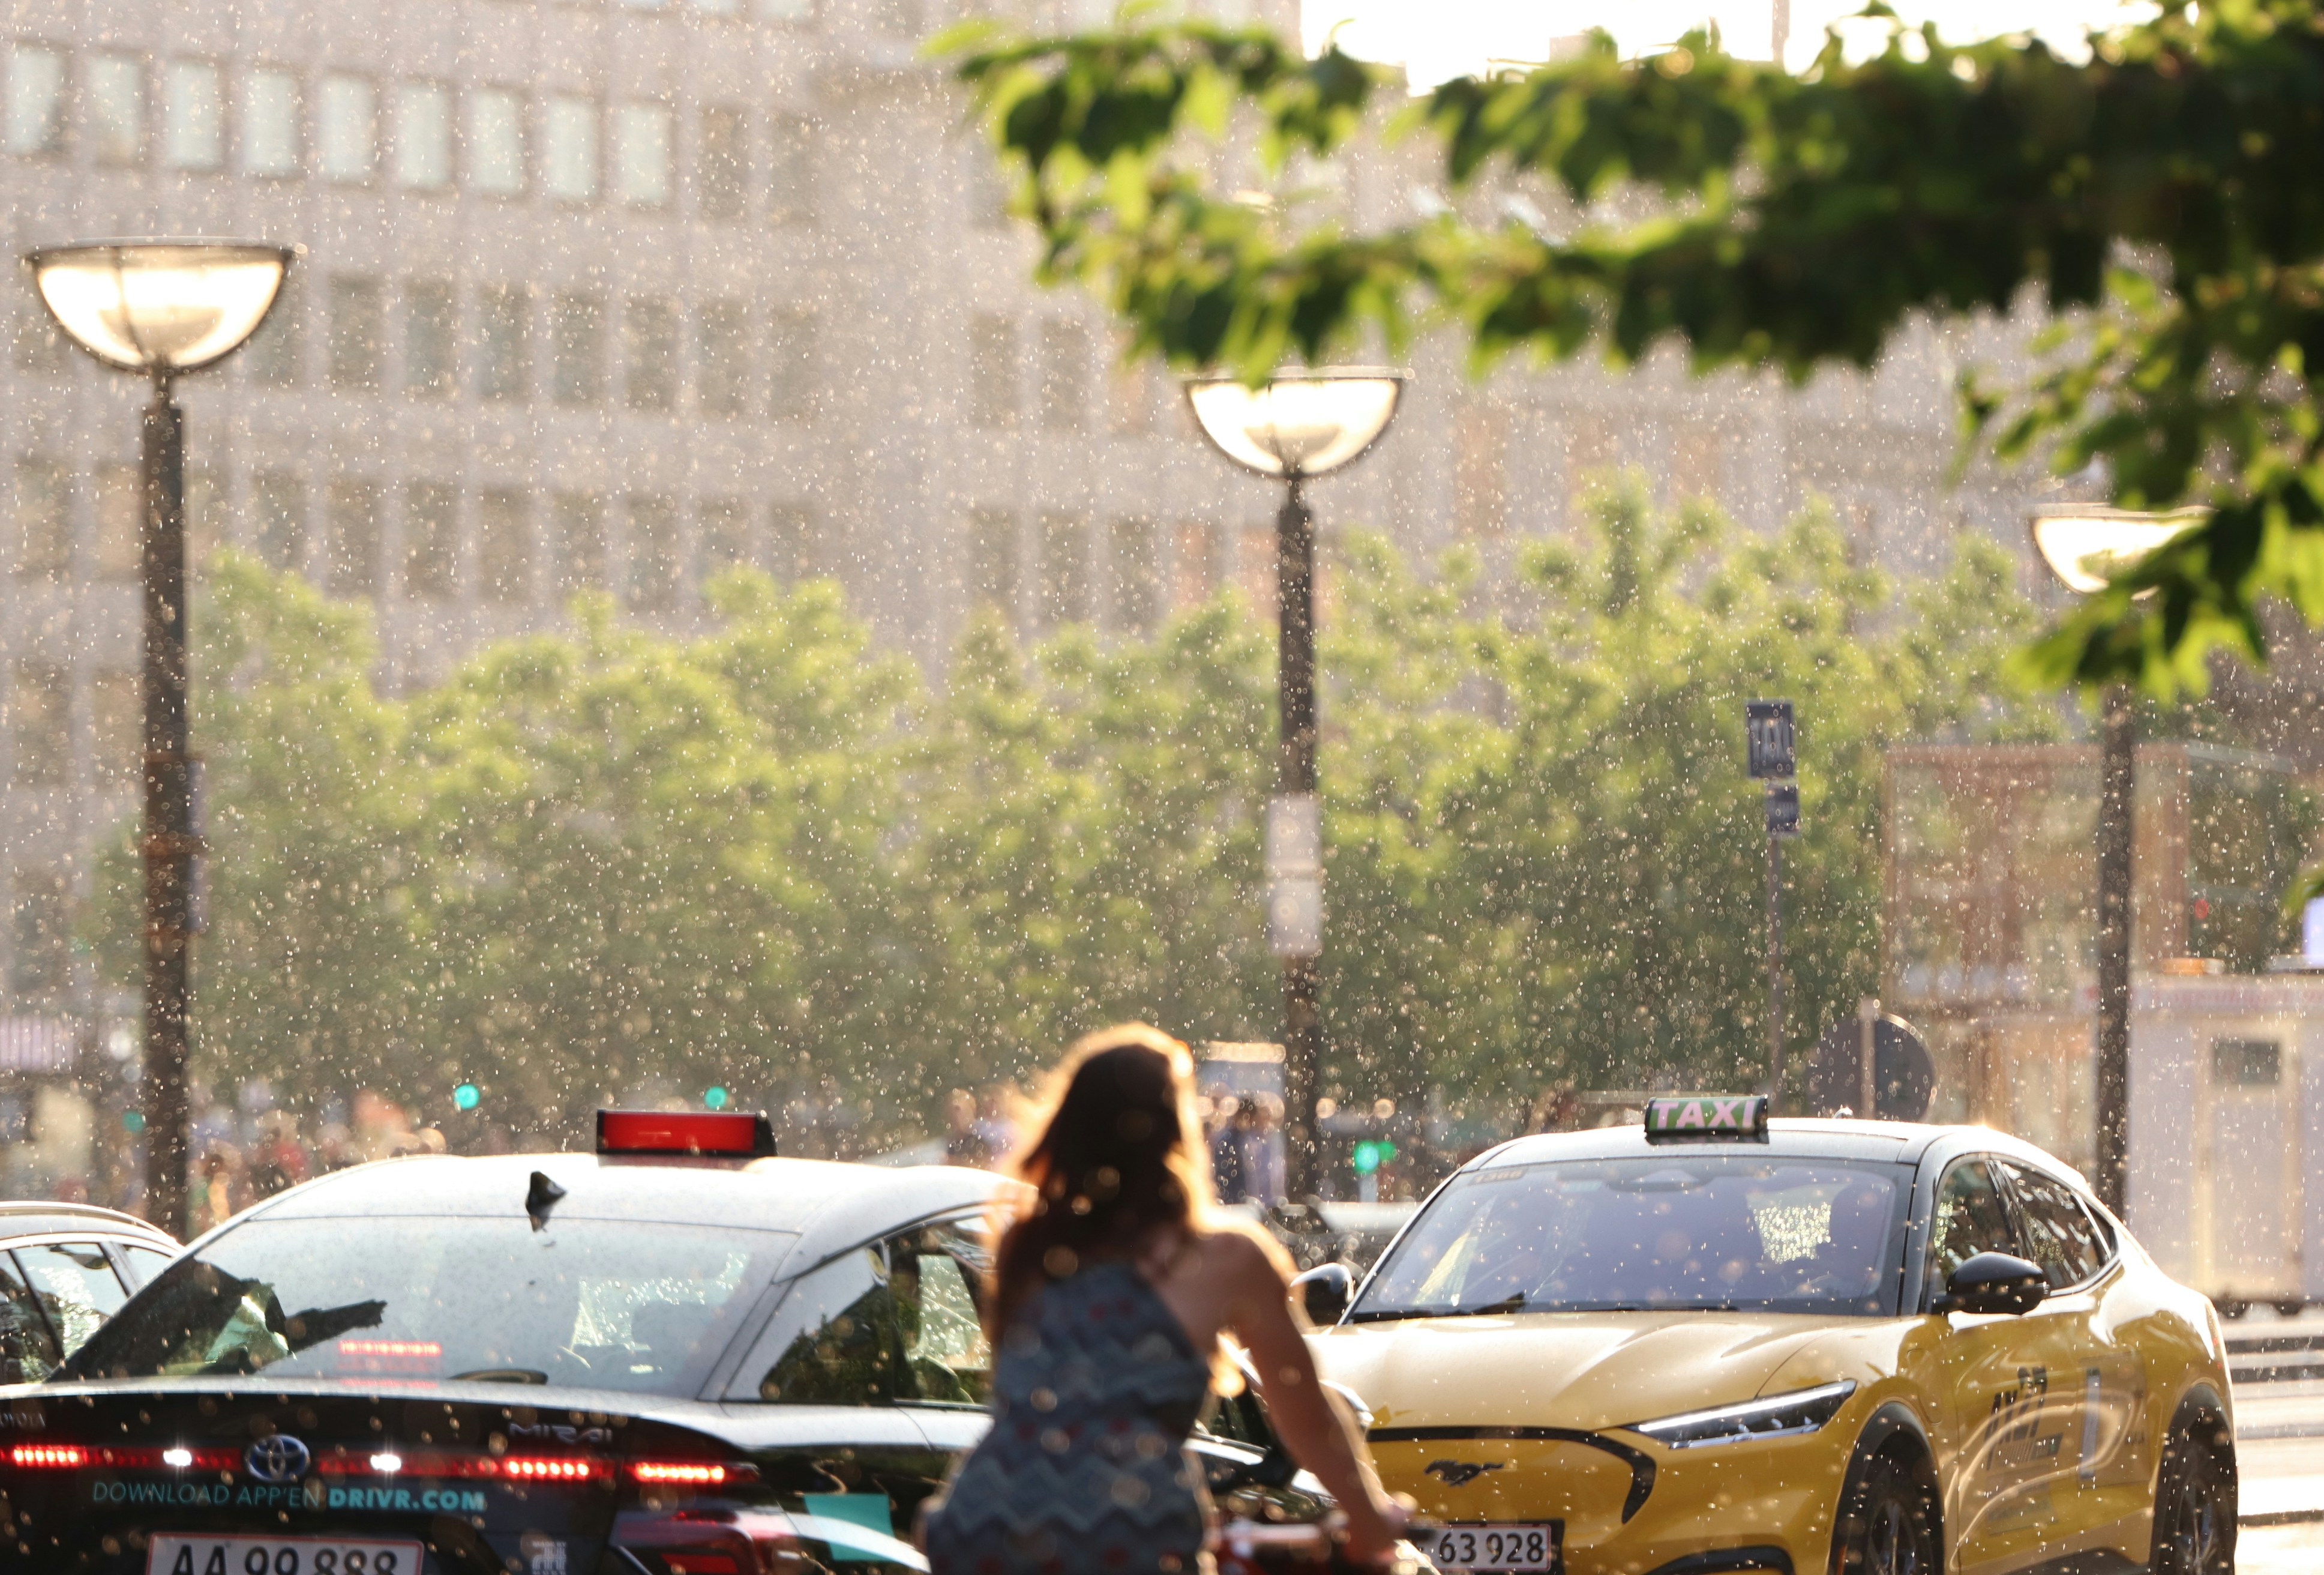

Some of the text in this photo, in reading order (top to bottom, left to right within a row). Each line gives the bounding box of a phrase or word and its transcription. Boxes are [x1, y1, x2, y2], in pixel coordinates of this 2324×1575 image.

[1652, 1100, 1756, 1130] TAXI
[93, 1481, 487, 1511] DOWNLOAD APP'EN DRIVR.COM
[170, 1544, 227, 1575] AA
[1439, 1531, 1543, 1564] 63 928
